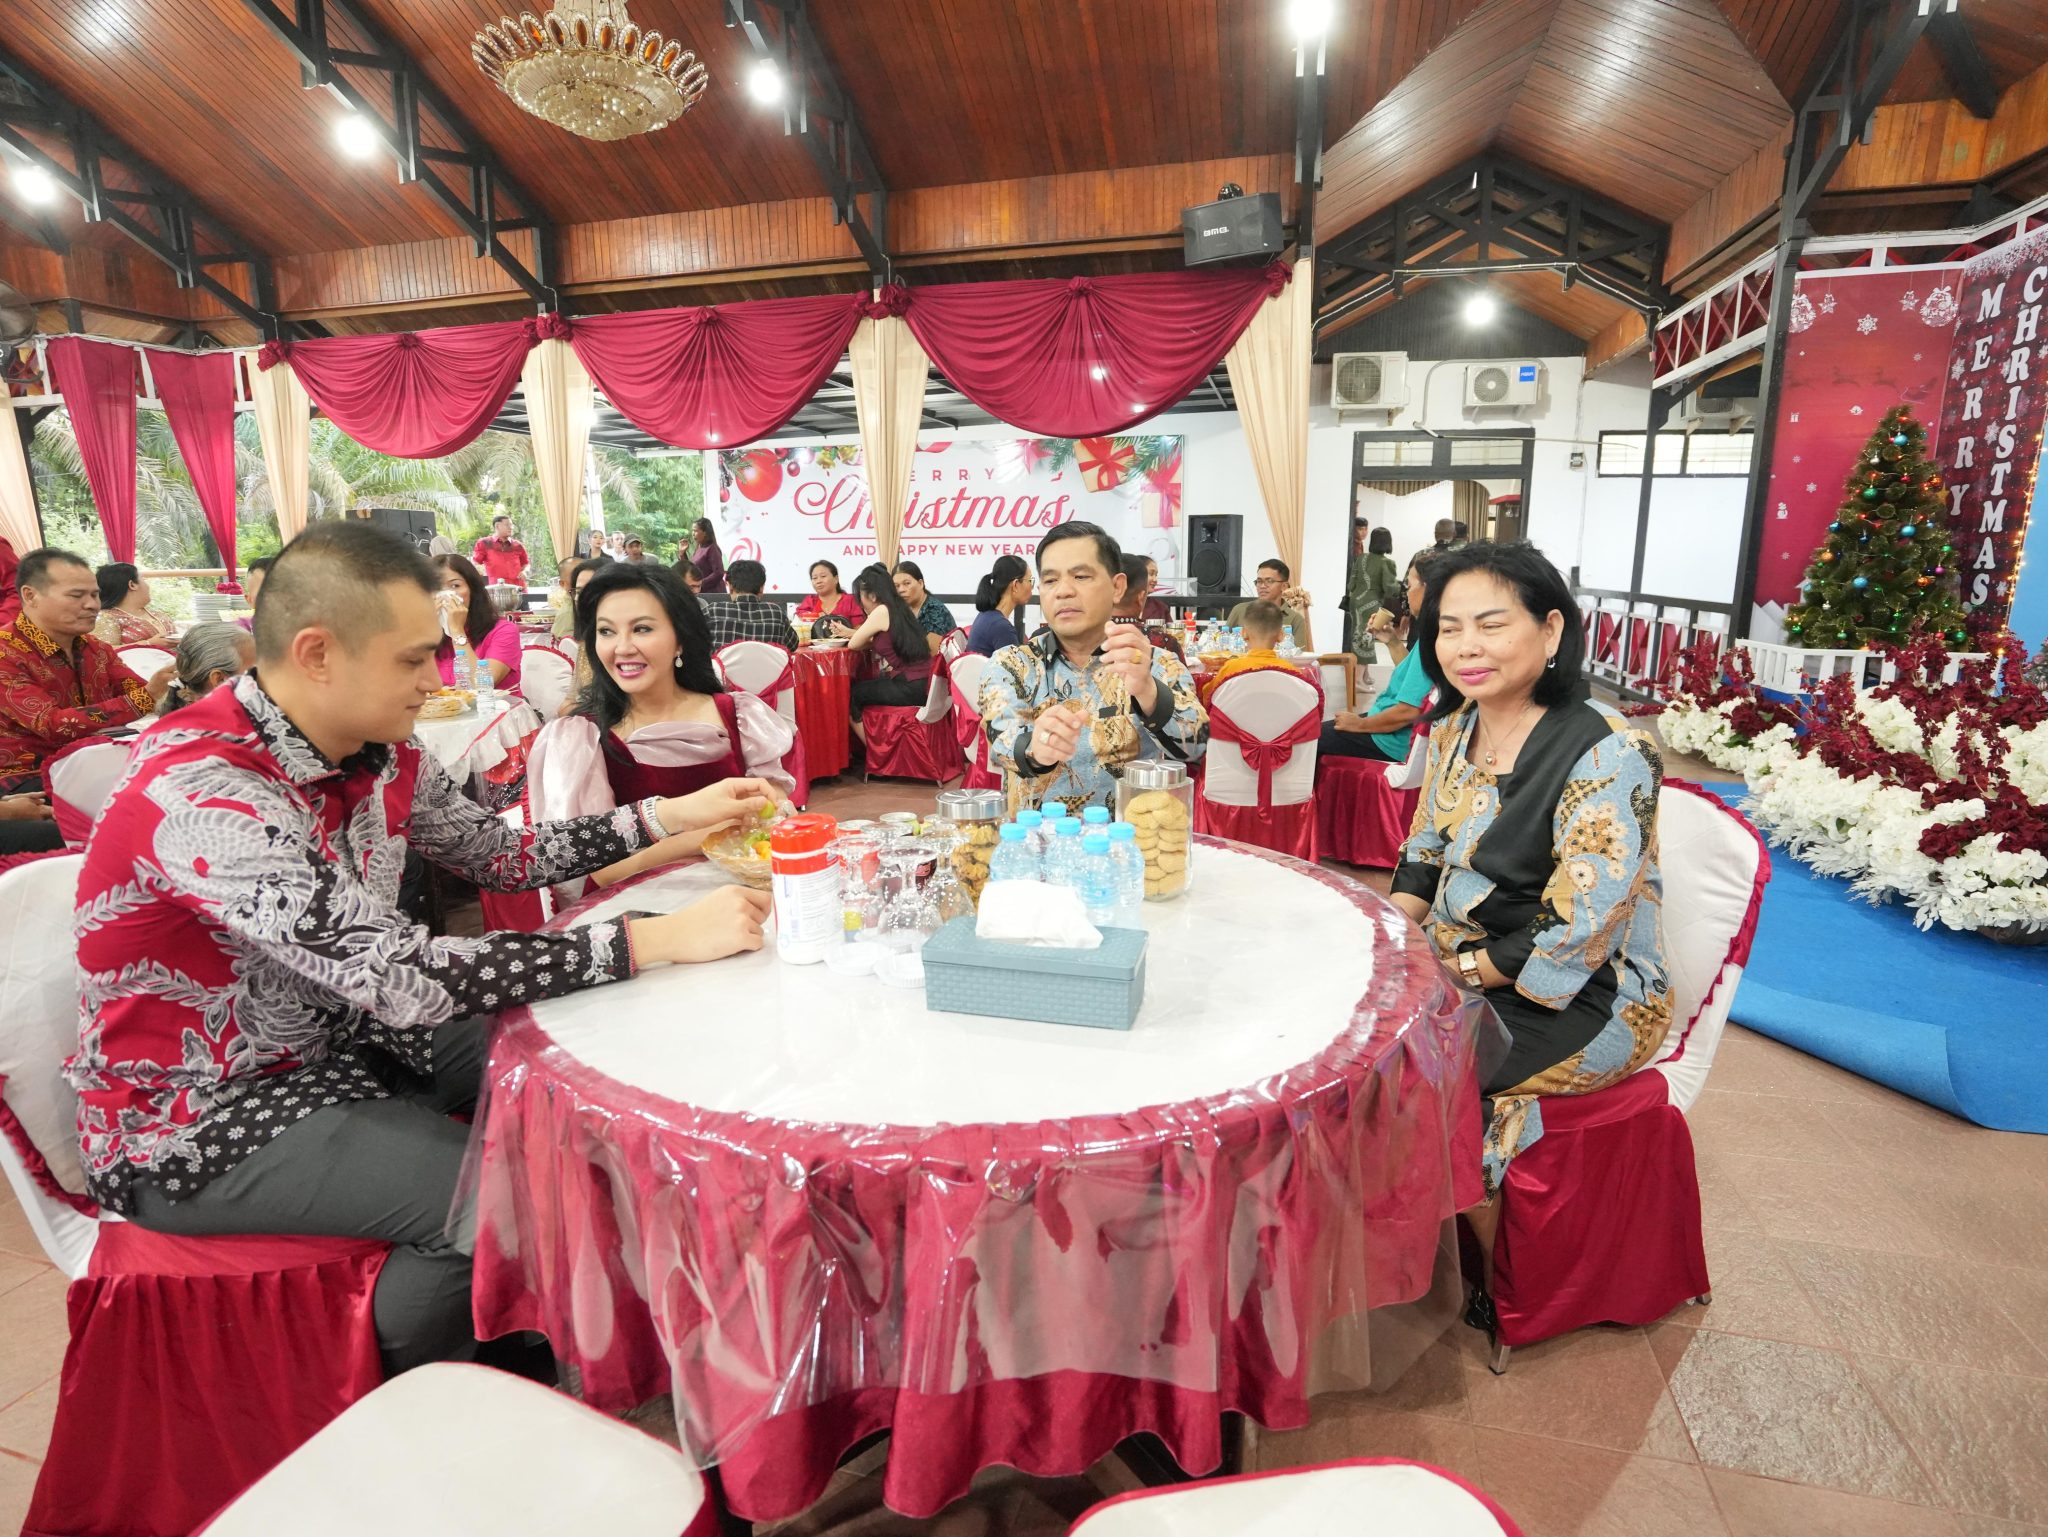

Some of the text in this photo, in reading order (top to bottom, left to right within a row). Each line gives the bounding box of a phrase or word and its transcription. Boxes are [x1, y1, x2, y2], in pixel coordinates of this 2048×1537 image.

[1950, 283, 2006, 516] MERRY
[1970, 266, 2048, 606] CHRISTMAS
[793, 474, 1075, 534] Chistmas
[909, 468, 994, 482] ERRY
[842, 543, 1036, 556] AND APPY NEW YEAR
